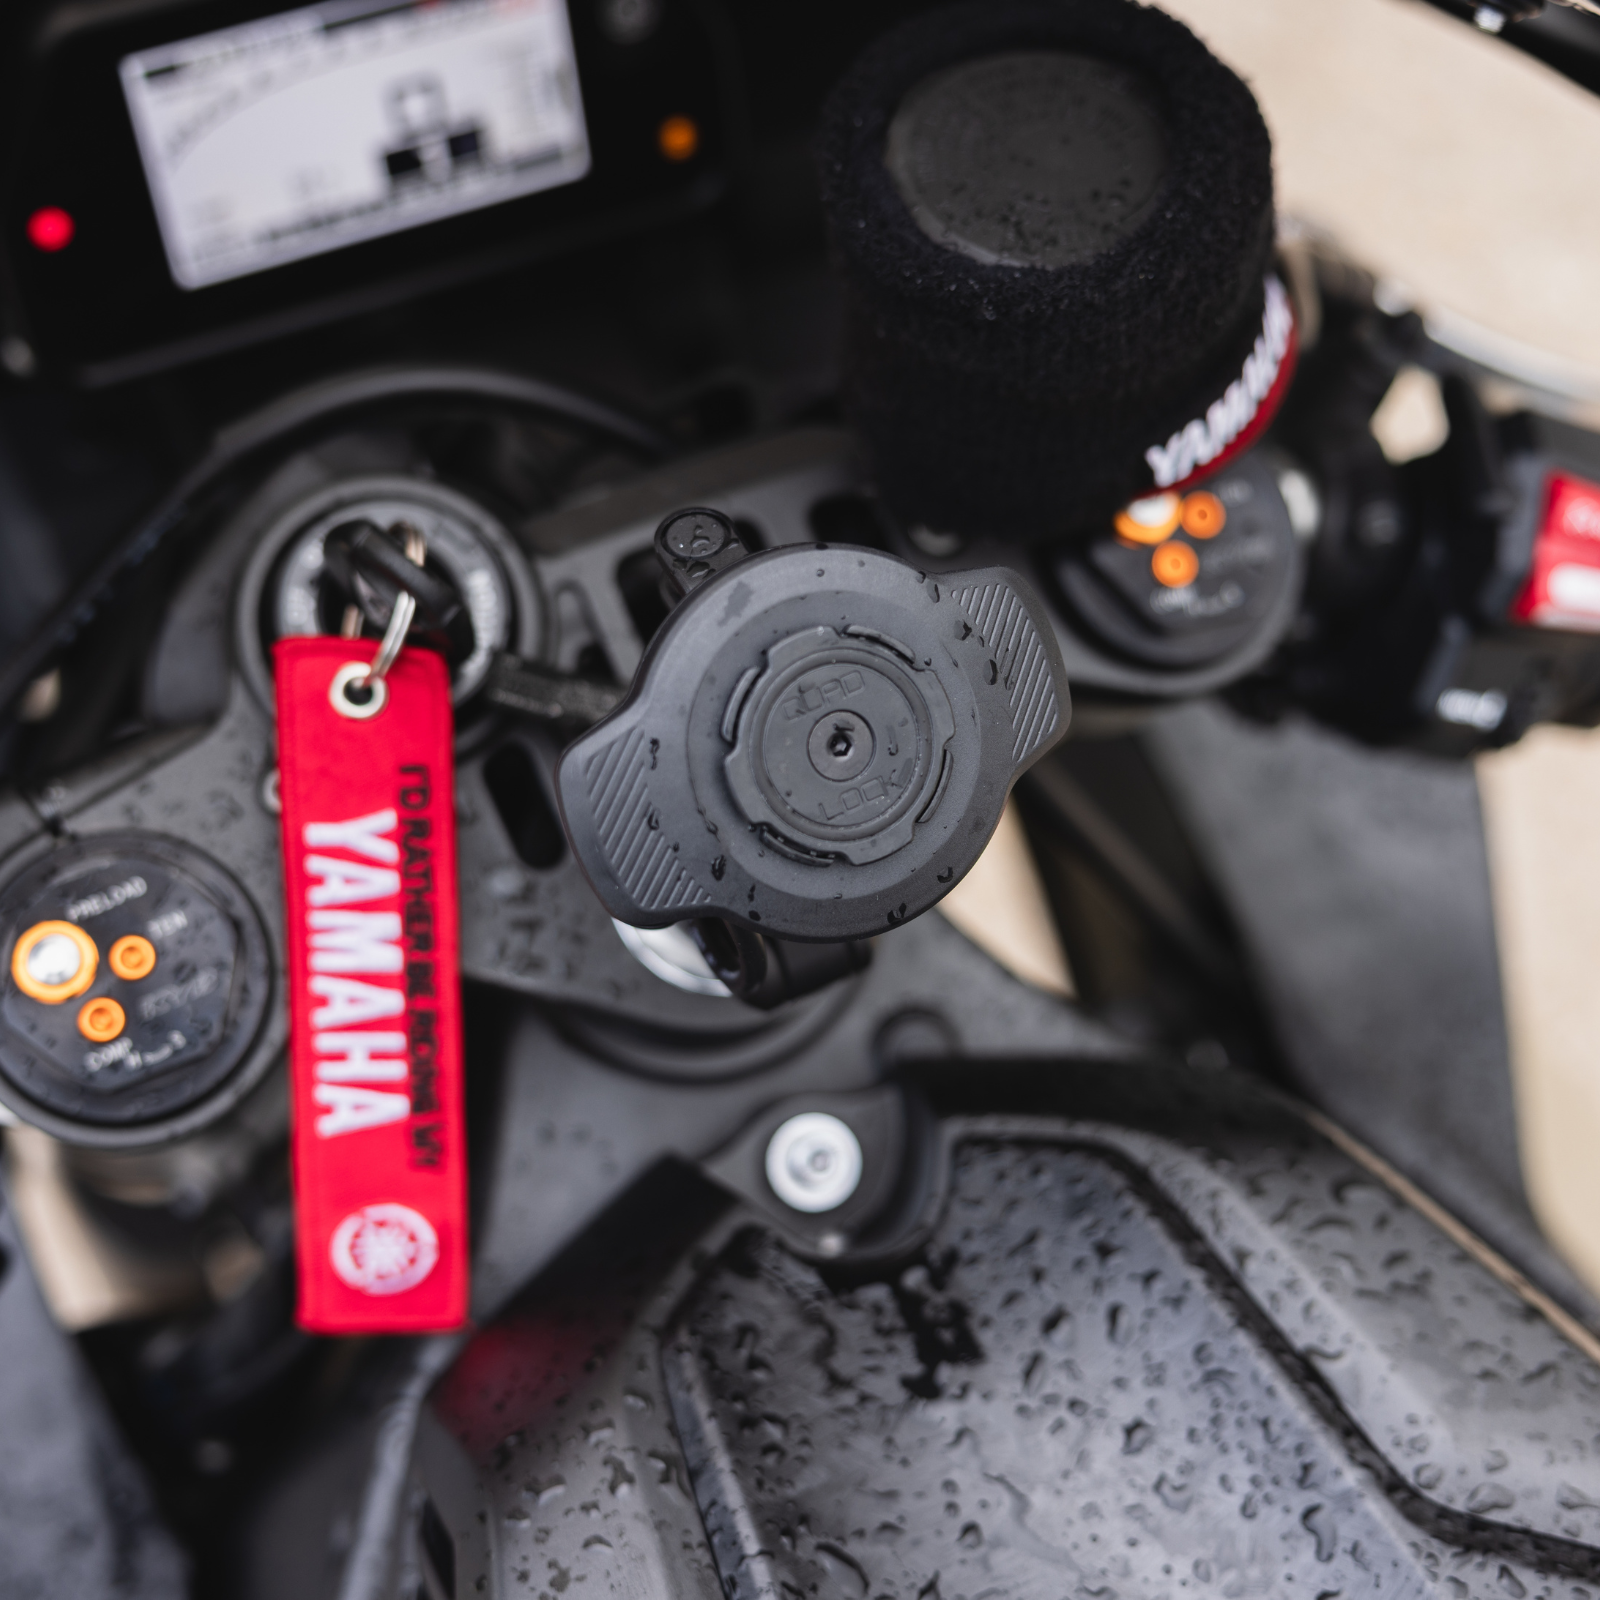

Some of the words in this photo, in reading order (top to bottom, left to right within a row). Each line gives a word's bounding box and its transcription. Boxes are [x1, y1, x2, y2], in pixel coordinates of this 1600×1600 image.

[782, 670, 865, 721] QUAD
[818, 768, 903, 821] LOCK
[66, 876, 147, 922] PRELOAD
[402, 818, 434, 953] RATHER
[148, 909, 188, 940] TEN
[302, 808, 411, 1139] YAMAHA
[84, 1037, 133, 1072] COMP
